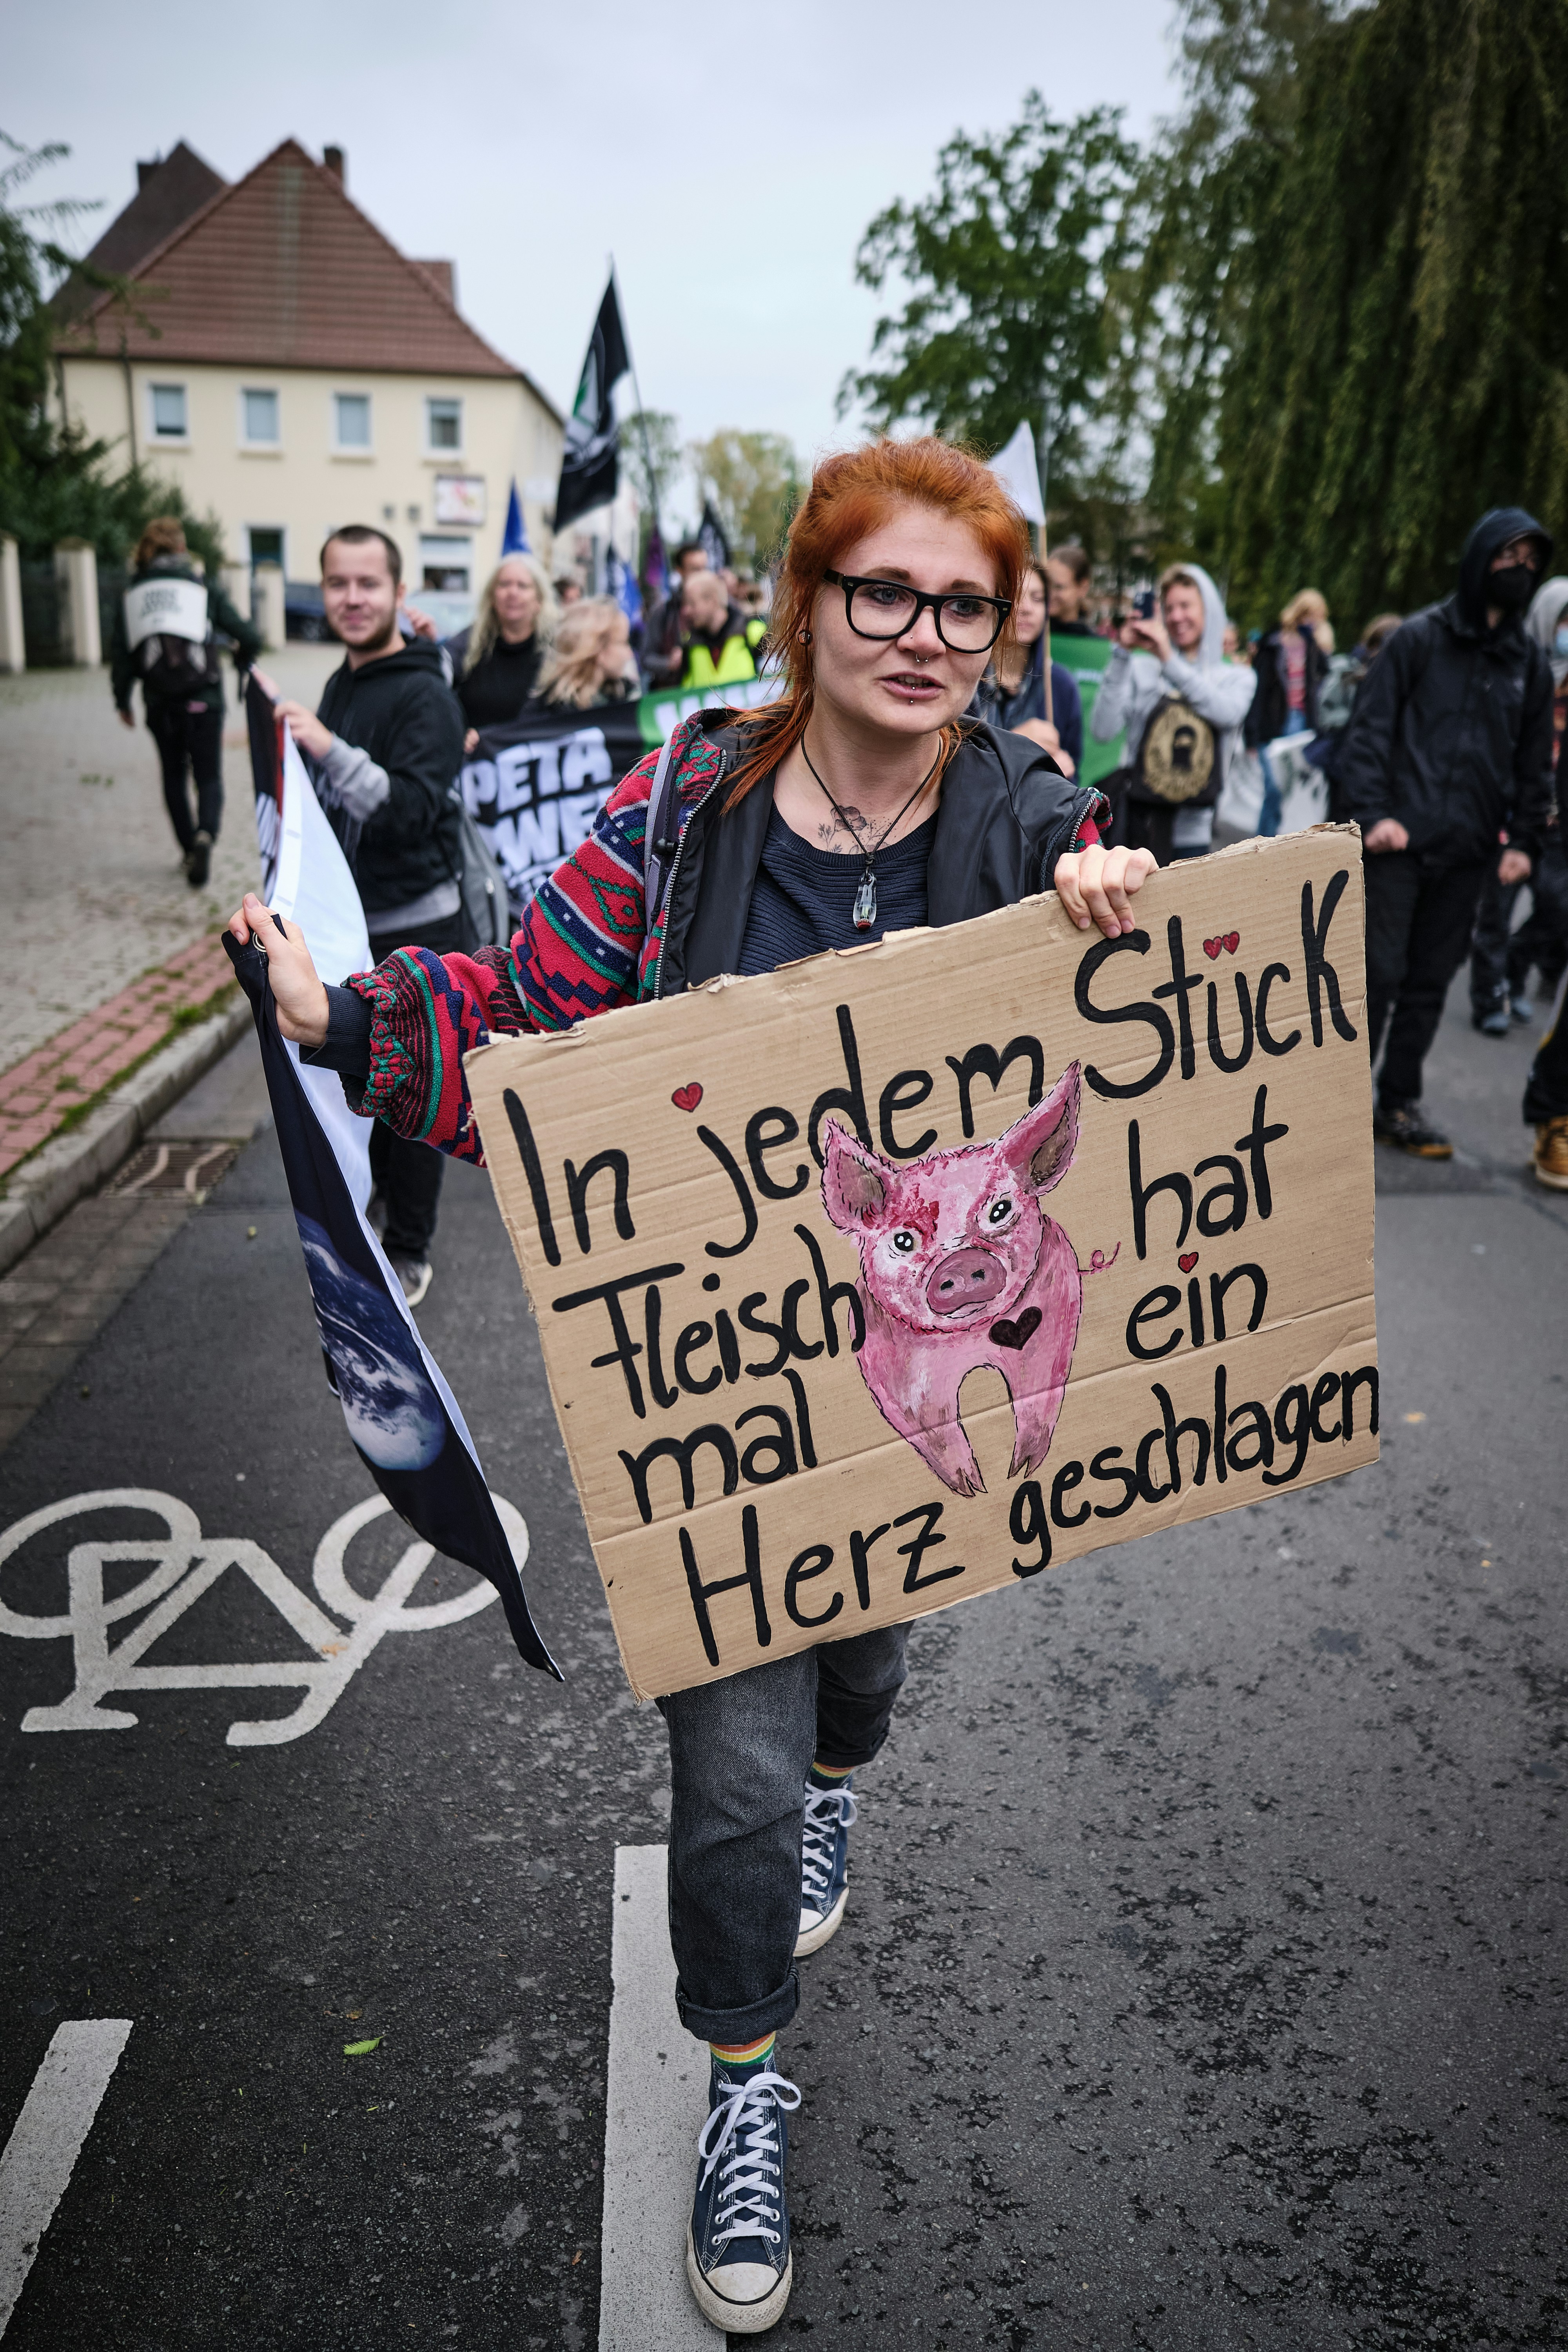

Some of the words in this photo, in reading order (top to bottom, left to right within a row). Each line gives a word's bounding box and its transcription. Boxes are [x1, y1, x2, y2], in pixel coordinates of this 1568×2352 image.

[460, 726, 612, 816] PETA
[503, 1087, 636, 1267] In
[671, 1004, 1045, 1259] jedem
[552, 1223, 867, 1420] Fleisch
[1128, 1083, 1289, 1261] hat
[617, 1368, 818, 1525] mal
[1125, 1251, 1269, 1360] ein
[678, 1502, 966, 1667] Herz
[1009, 1364, 1379, 1575] geschlagen
